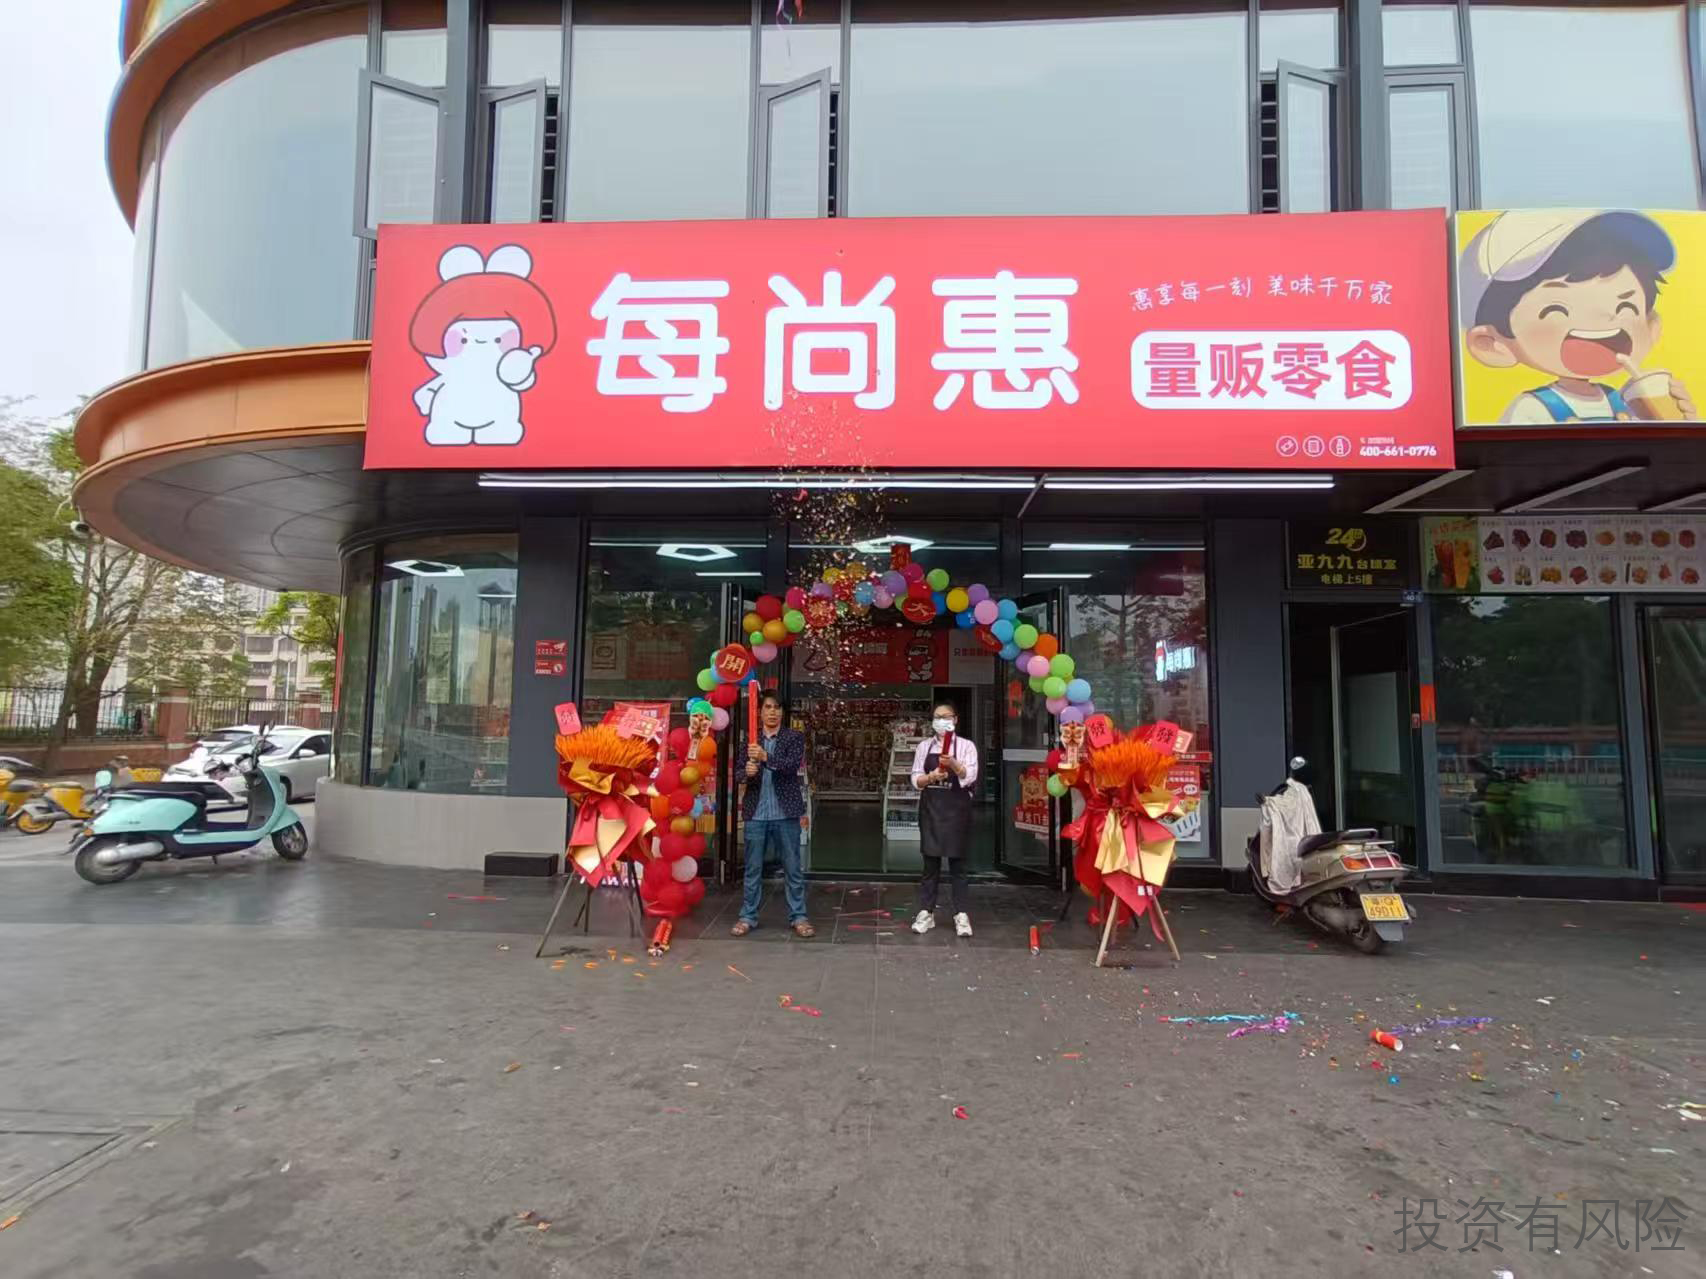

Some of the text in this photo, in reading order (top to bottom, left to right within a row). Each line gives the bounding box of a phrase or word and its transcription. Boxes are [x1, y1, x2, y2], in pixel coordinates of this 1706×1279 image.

[1131, 275, 1393, 311] 惠享每一刻 美味千万家
[586, 270, 1080, 413] 每尚惠
[1144, 339, 1397, 400] 量贩零食
[1359, 445, 1437, 457] 400-661-0776
[719, 653, 746, 675] 開
